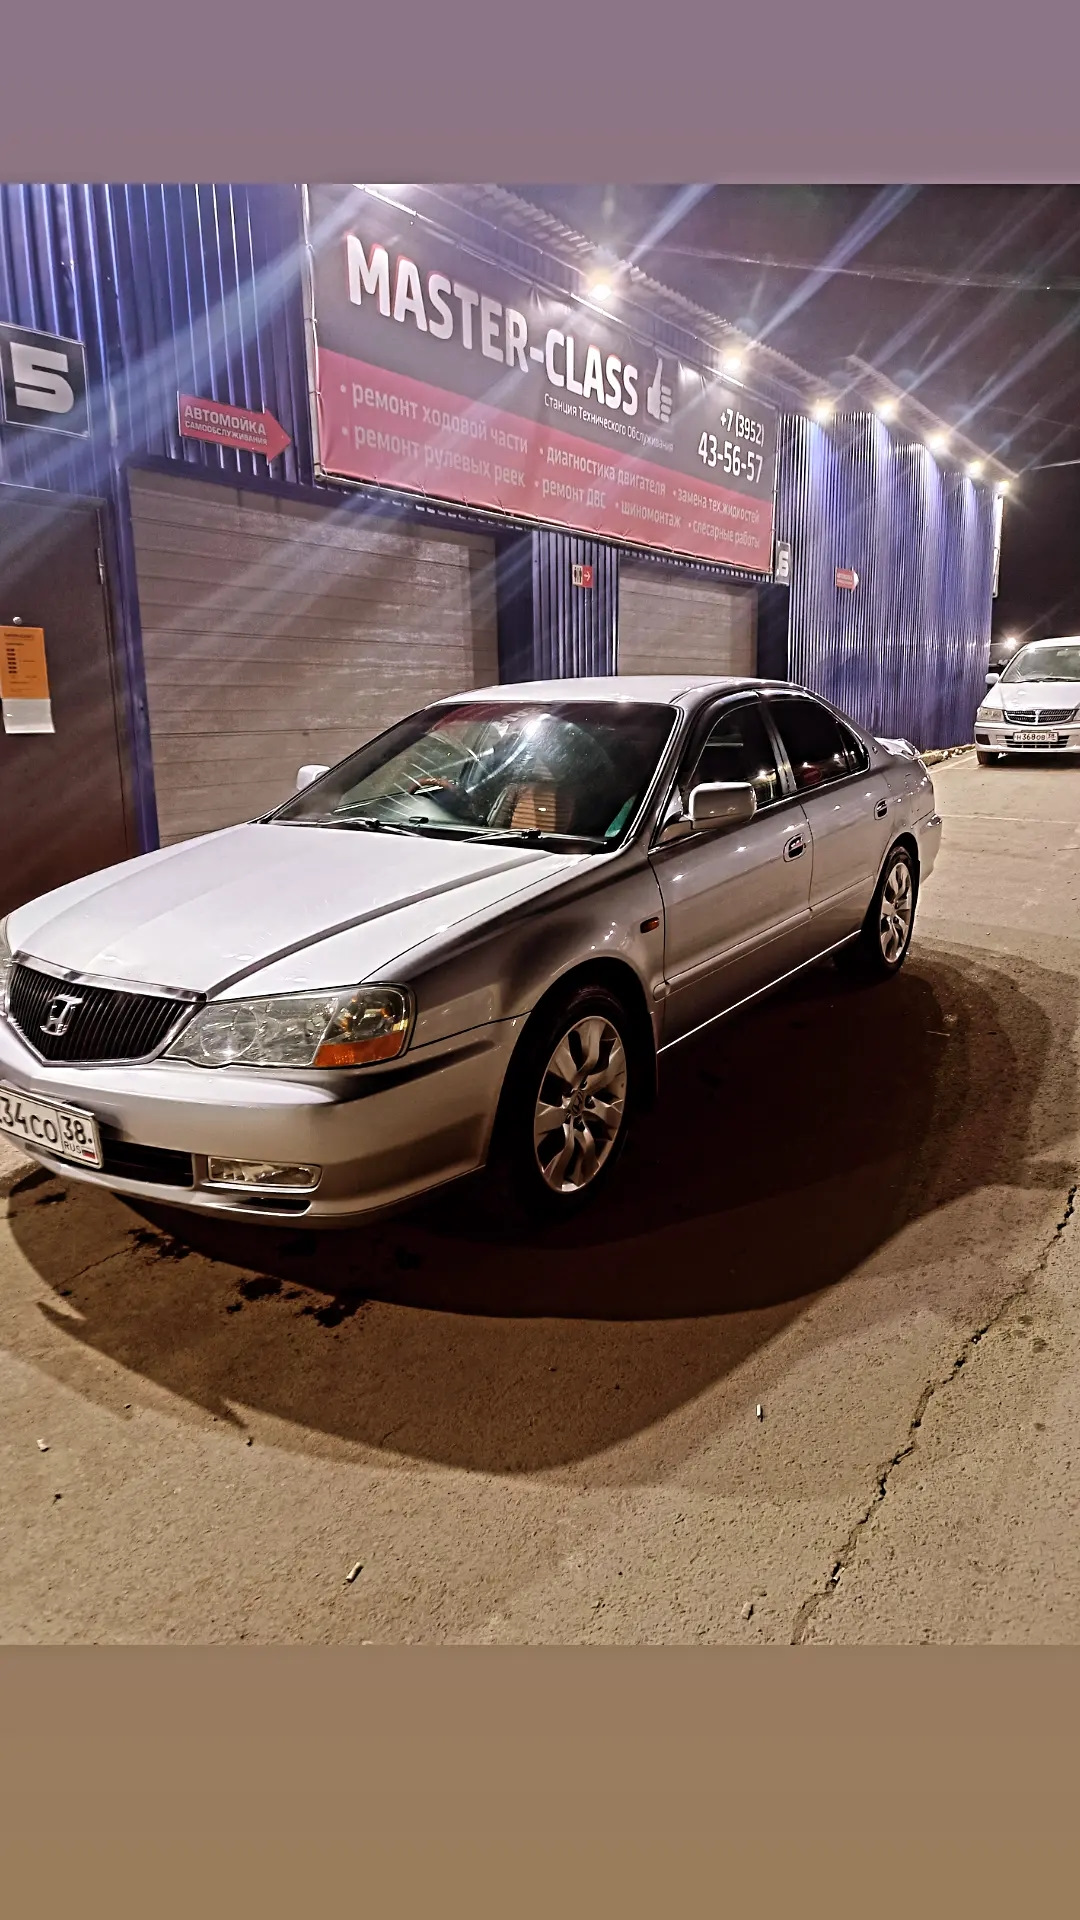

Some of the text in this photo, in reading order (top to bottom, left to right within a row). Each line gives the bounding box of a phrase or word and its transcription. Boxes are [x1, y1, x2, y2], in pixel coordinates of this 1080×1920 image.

[346, 233, 639, 416] MASTER-CLASS
[9, 341, 75, 414] 5
[184, 405, 267, 436] АВТОМОЙКА
[184, 420, 268, 446] САМООБСЛУЖИВАНИЯ
[352, 382, 528, 454] ремонт ходовой части
[543, 393, 674, 453] Станция Технического Обслуживания
[720, 408, 765, 448] +7 (3952)
[354, 425, 526, 488] ремонт рулевых реек
[546, 446, 666, 496] диагностика двигателя
[698, 431, 764, 484] 43-56-57
[542, 478, 607, 509] ремонт ДВС
[621, 501, 682, 528] шиномонтаж
[678, 488, 707, 509] замена
[692, 520, 760, 549] слесарные работы
[0, 1095, 87, 1145] 34CO 38
[63, 1141, 82, 1154] RUS
